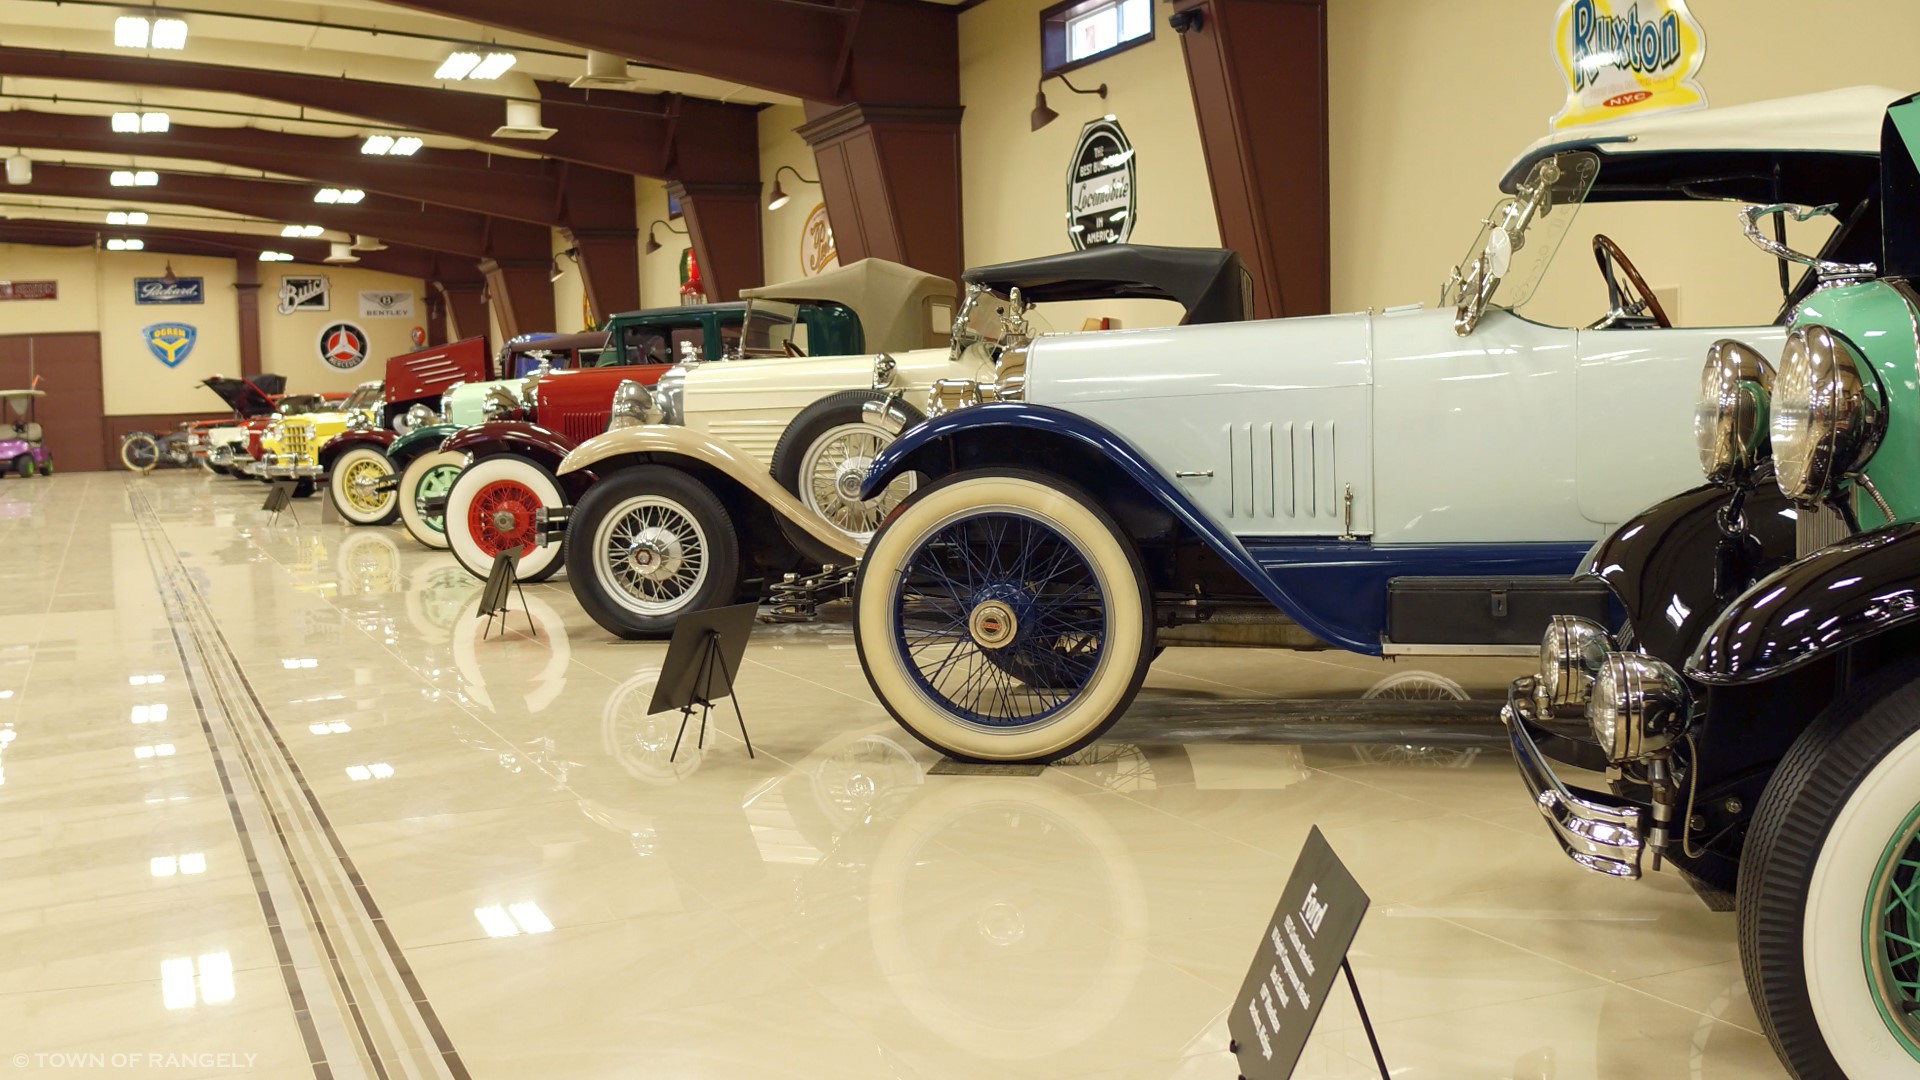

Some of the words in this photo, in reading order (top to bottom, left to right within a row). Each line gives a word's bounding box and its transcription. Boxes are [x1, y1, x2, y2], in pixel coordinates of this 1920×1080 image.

[1572, 0, 1681, 93] Ruxton
[1093, 146, 1104, 158] THE
[1080, 163, 1093, 177] BEST
[1074, 176, 1129, 212] Locomobile
[1095, 216, 1104, 229] IN
[1086, 228, 1115, 244] AMERICA
[141, 282, 198, 300] Packard
[278, 274, 331, 315] Buick
[366, 309, 409, 317] BENTLEY
[153, 327, 186, 338] OGREN
[328, 355, 363, 368] MERCEDES
[1301, 882, 1328, 934] Ford
